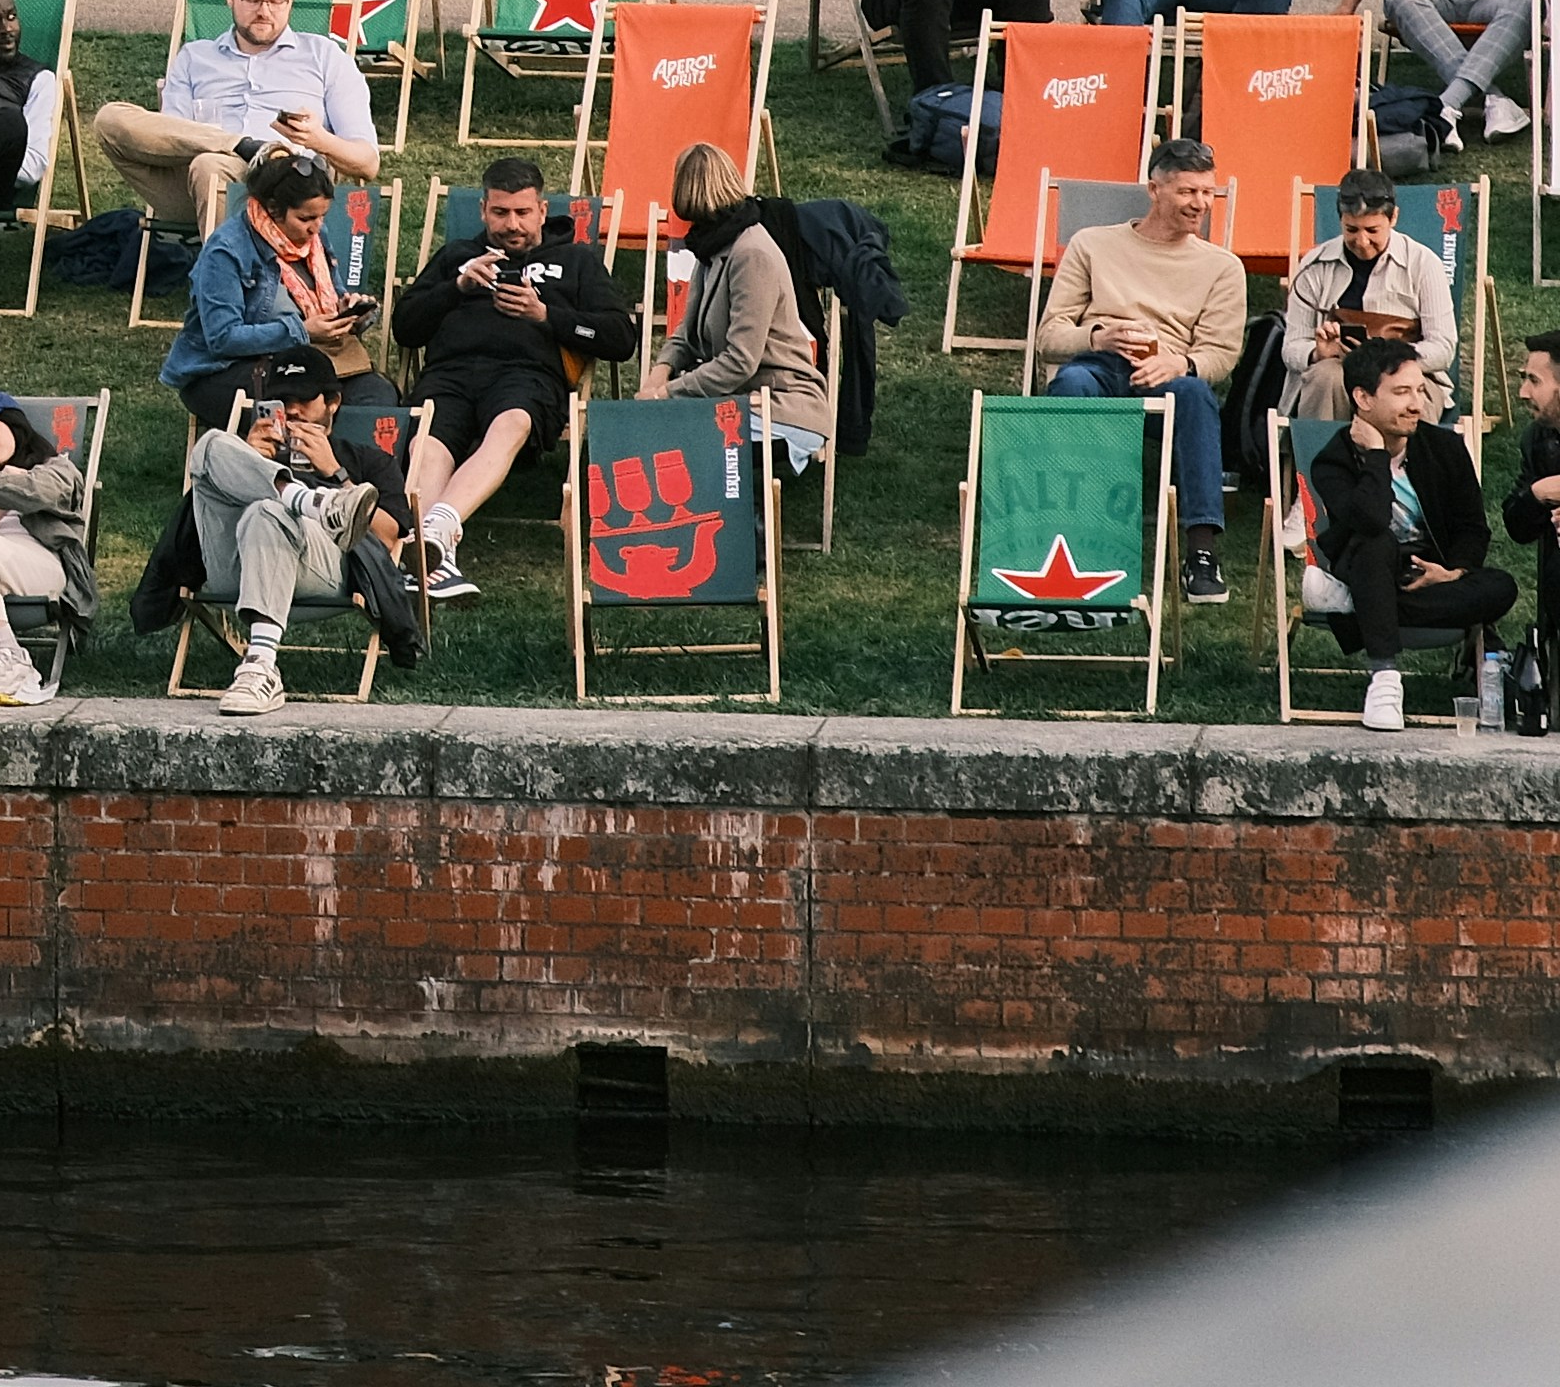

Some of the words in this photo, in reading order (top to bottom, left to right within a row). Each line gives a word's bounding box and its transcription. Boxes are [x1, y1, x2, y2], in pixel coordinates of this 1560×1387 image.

[652, 53, 717, 81] APEROL
[662, 70, 706, 89] SPRITZ
[1248, 64, 1314, 92] APEROL
[1042, 73, 1108, 100] APEROL
[1053, 90, 1097, 109] SPRITZ
[1258, 81, 1303, 102] SPRITZ
[347, 235, 365, 286] BERLINER
[724, 447, 741, 499] BERLINER
